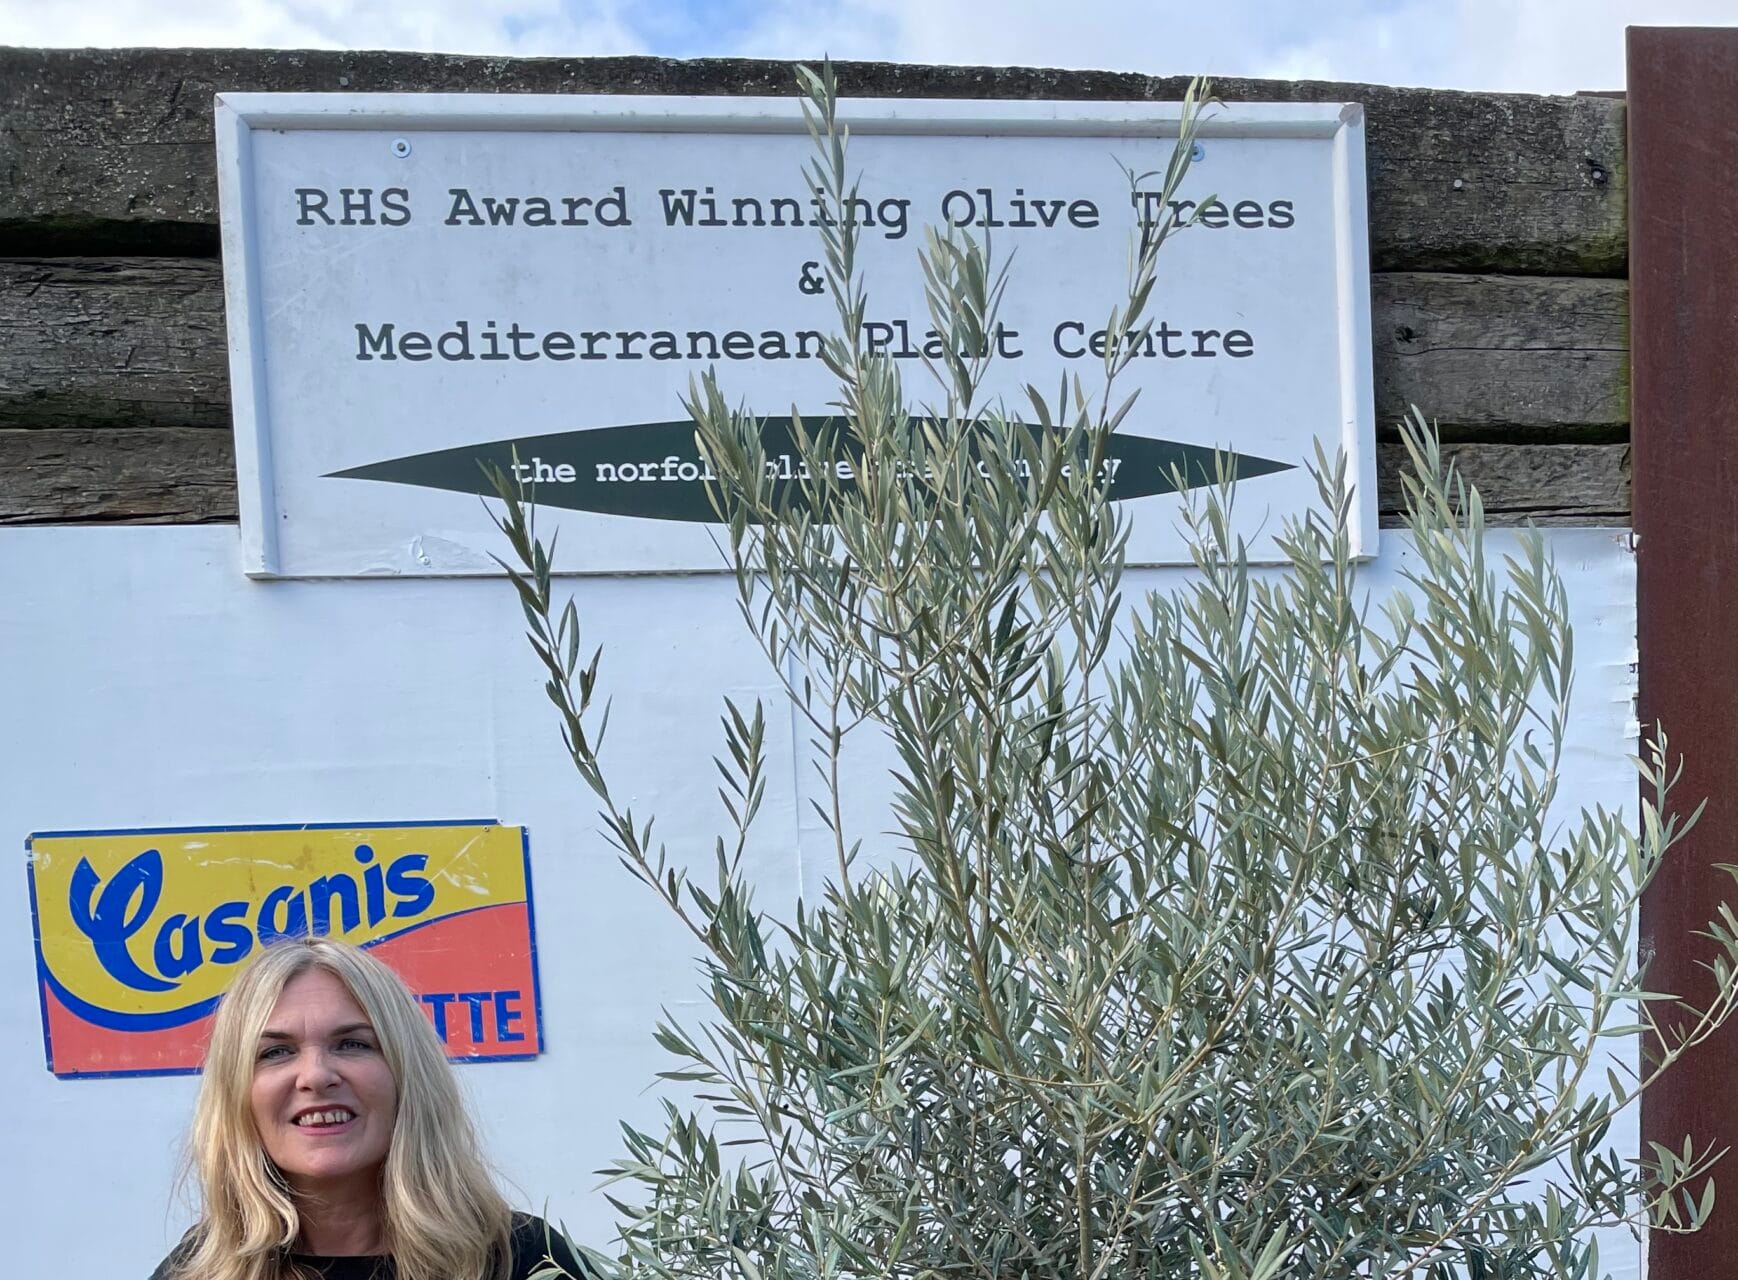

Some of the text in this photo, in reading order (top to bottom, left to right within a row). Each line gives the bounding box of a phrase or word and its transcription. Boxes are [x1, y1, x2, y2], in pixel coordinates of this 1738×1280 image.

[295, 186, 1295, 240] RHS Award Winning Olive Trees
[798, 261, 825, 295] &
[354, 320, 826, 362] Mediterranean
[1053, 321, 1254, 359] Centre
[511, 457, 576, 483] the
[596, 456, 738, 482] norfol
[69, 844, 436, 993] Casanis
[412, 990, 525, 1044] TTE
